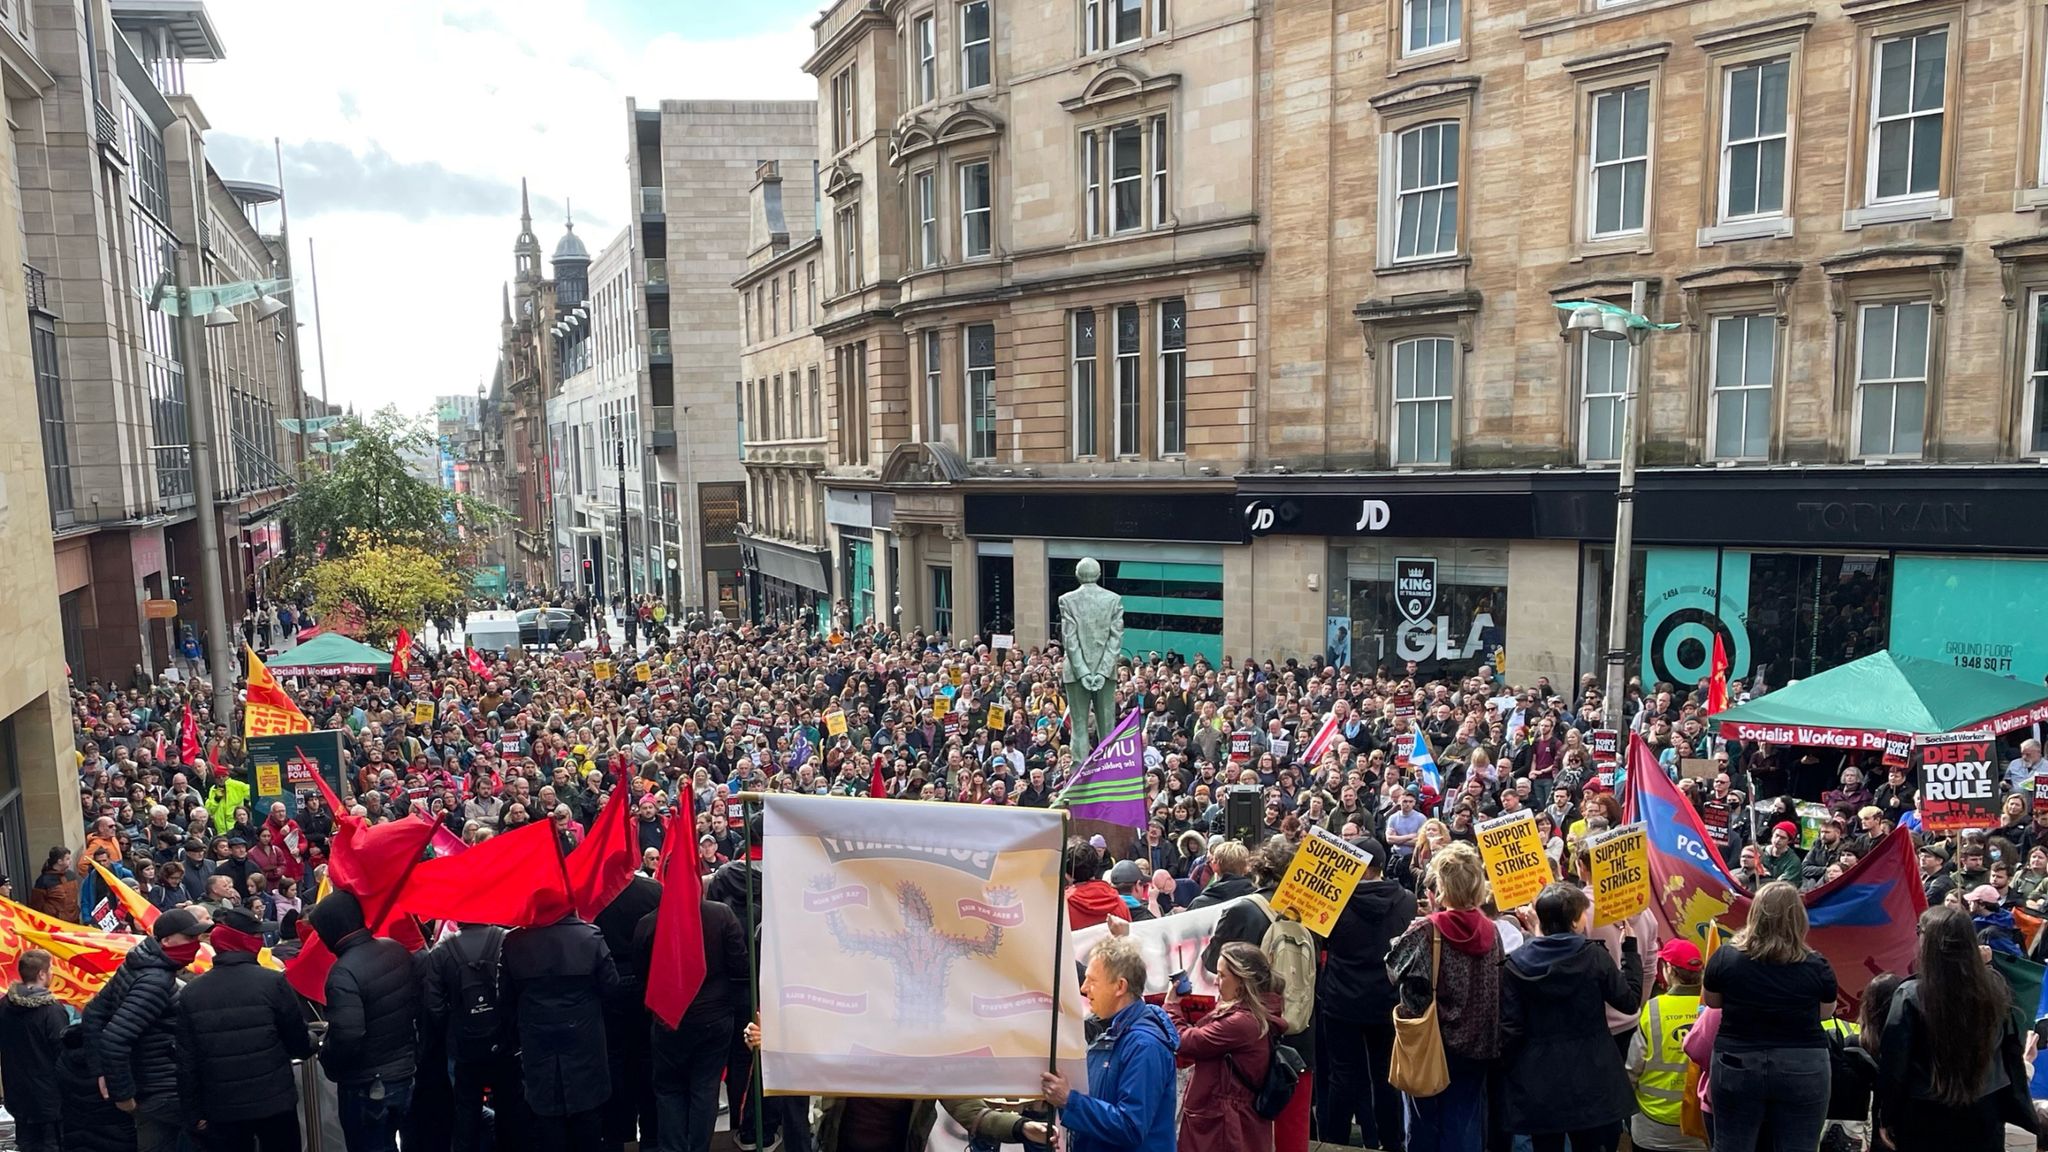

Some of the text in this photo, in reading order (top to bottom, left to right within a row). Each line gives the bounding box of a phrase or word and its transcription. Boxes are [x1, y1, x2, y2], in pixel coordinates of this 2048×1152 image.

[1252, 508, 1274, 530] JD
[1356, 500, 1390, 530] JD
[1400, 578, 1432, 591] KING
[1946, 641, 2014, 658] GROUND FLOOR
[272, 666, 365, 676] Socialist Workers Party
[1984, 658, 1997, 672] SQ
[2000, 658, 2012, 671] FT
[1994, 714, 2029, 733] Workers
[1738, 726, 1794, 742] Socialist
[1798, 728, 1857, 747] Workers
[1887, 741, 1909, 751] TORY
[1925, 734, 1958, 743] Socialist
[1886, 748, 1908, 757] RULE
[1923, 743, 1990, 764] DEFY
[1922, 761, 1992, 782] TORY
[1926, 780, 1992, 800] RULE
[1482, 814, 1525, 831] Socialist Worker
[1483, 822, 1532, 848] SUPPORT
[1595, 826, 1639, 845] Socialist Worker
[1317, 832, 1363, 859] Socialist Worker
[1502, 841, 1524, 858] THE
[1595, 835, 1642, 864] SUPPORT
[1306, 840, 1360, 876] SUPPORT
[1495, 852, 1540, 876] STRIKES
[1609, 855, 1628, 873] THE
[1314, 860, 1338, 882] THE
[1600, 866, 1641, 894] STRIKES
[1294, 868, 1342, 902] STRIKES
